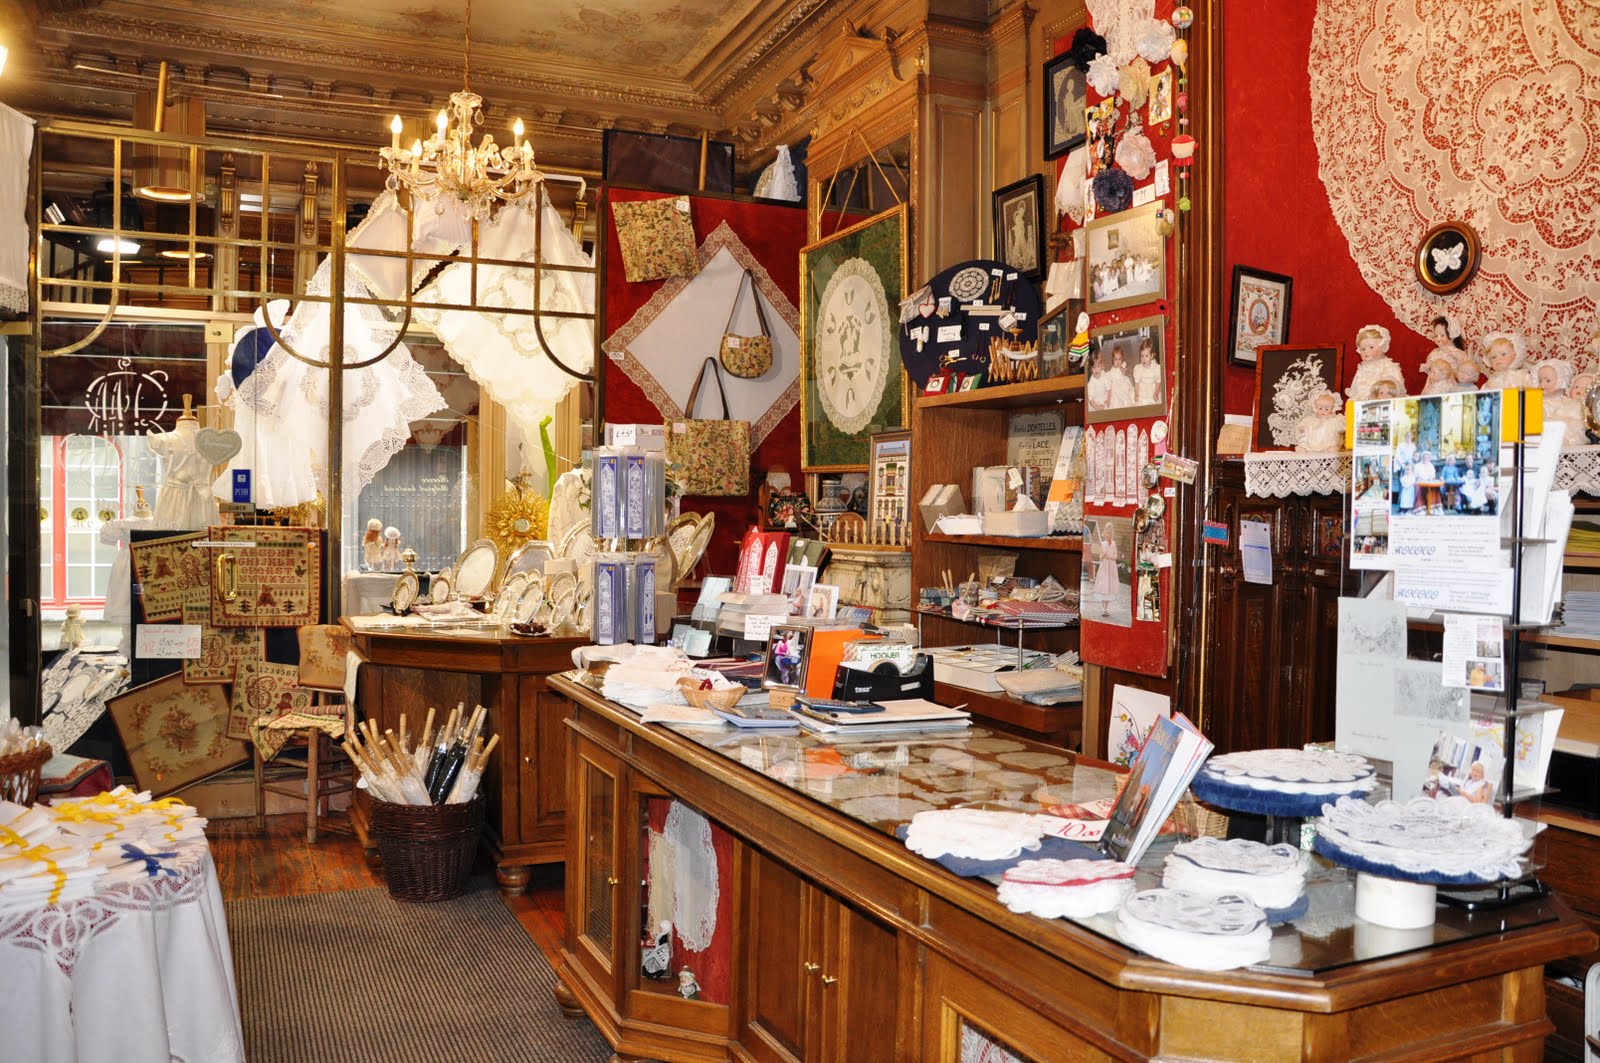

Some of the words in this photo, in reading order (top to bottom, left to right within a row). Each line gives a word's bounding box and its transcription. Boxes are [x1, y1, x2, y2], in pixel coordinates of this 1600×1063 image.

[234, 488, 249, 496] PUSH
[1394, 545, 1436, 556] ROCOCO
[1398, 588, 1439, 600] ROCOCO
